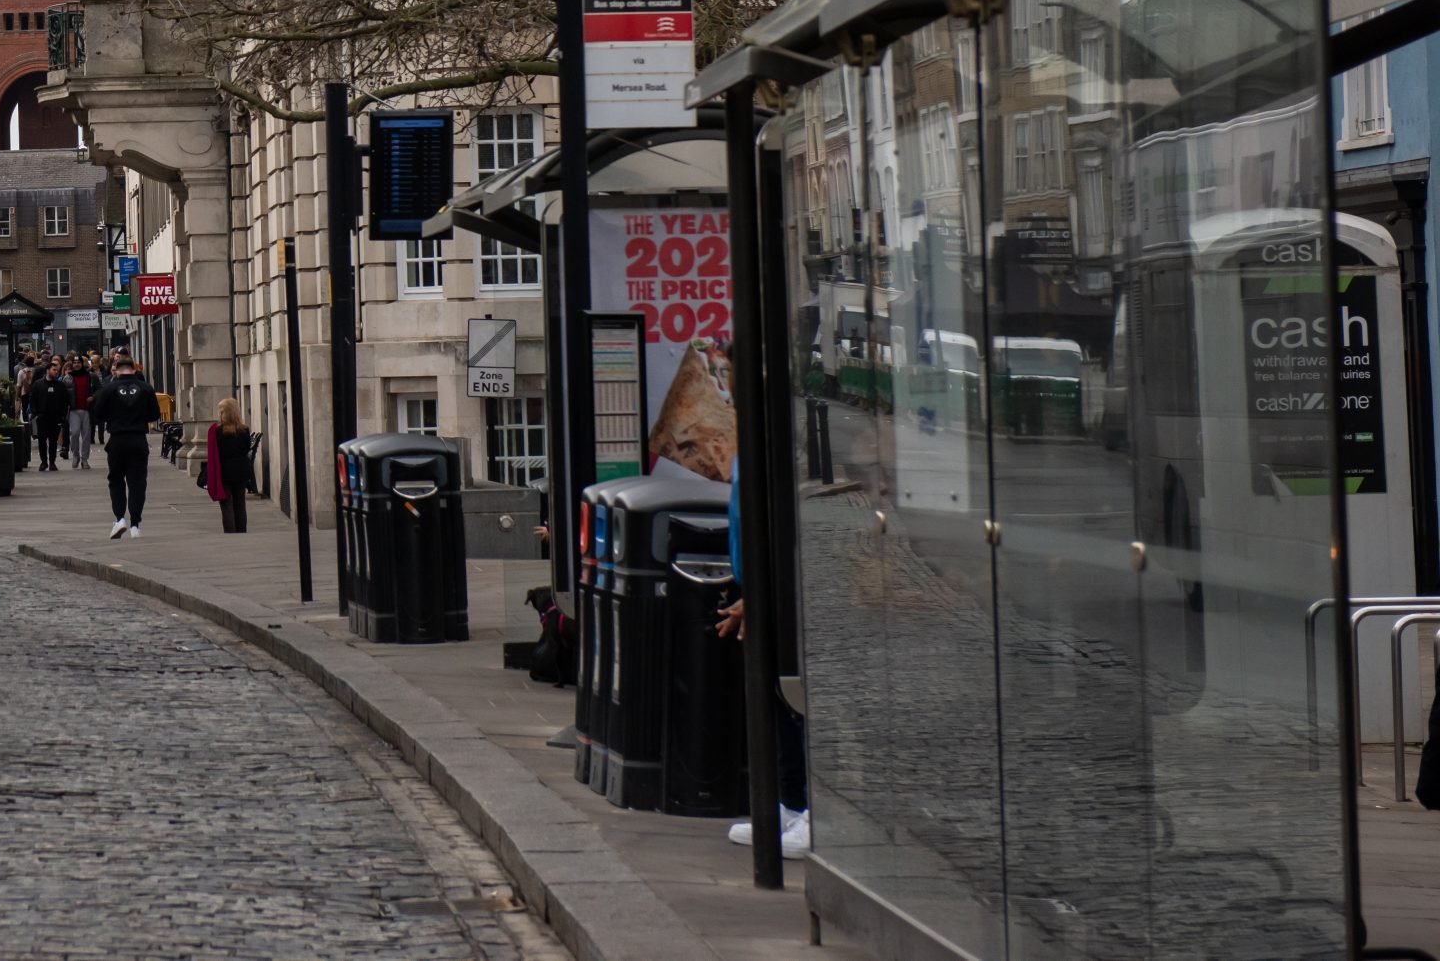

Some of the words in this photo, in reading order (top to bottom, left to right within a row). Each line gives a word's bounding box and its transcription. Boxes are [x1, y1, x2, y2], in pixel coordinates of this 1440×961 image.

[593, 0, 608, 8] Bus
[609, 0, 625, 9] stop
[626, 0, 646, 7] code:
[612, 83, 643, 92] Mersea
[624, 214, 654, 235] THE
[625, 236, 729, 278] 202
[144, 286, 172, 295] FIVE
[626, 281, 656, 301] THE
[141, 296, 175, 305] GUYS
[627, 302, 733, 343] 202
[1251, 306, 1369, 349] cash
[1253, 354, 1328, 368] withdrawa
[1343, 352, 1370, 365] and
[479, 371, 503, 379] Zone
[1254, 371, 1275, 382] free
[1278, 370, 1320, 382] balance
[473, 382, 510, 393] ENDS
